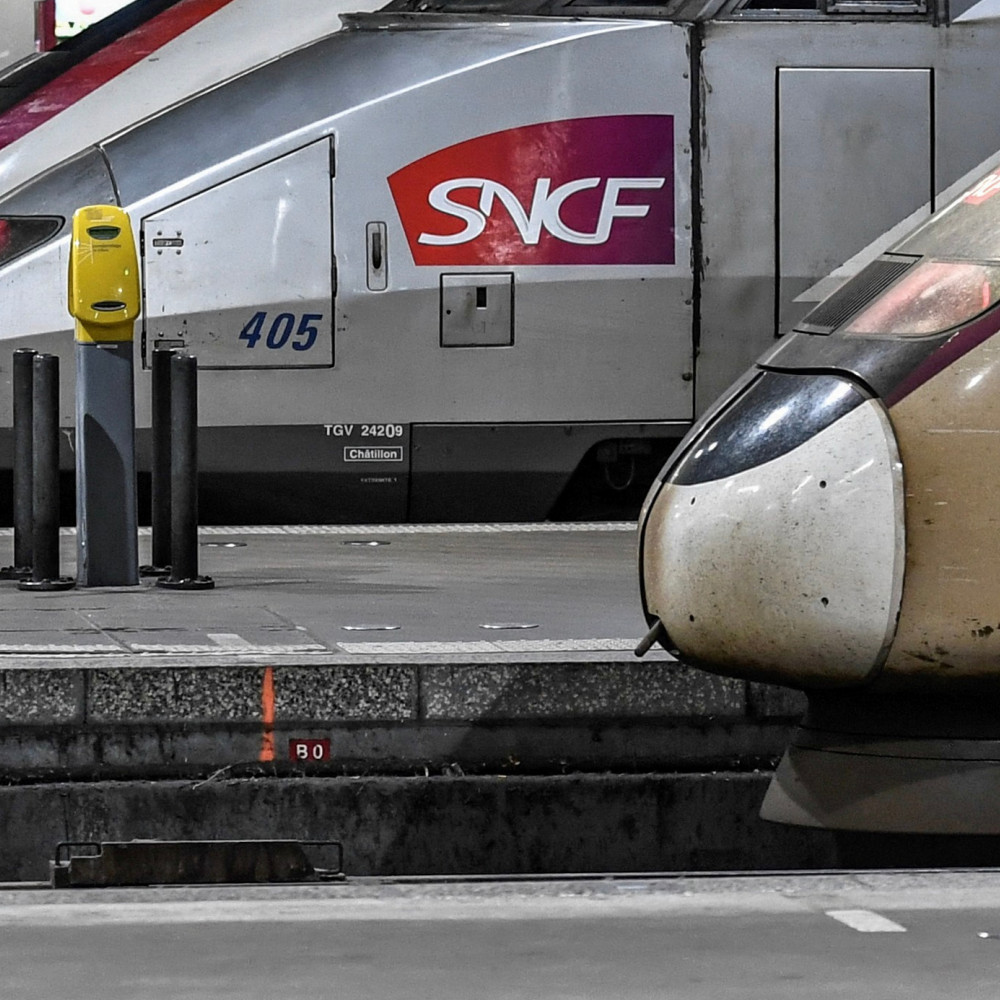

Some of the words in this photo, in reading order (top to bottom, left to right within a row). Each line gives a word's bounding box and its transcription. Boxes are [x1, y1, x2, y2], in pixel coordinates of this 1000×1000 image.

[417, 177, 666, 246] SNCF
[238, 311, 323, 351] 405
[323, 424, 354, 437] TGV
[360, 423, 404, 438] 24209
[349, 449, 398, 459] Châtillon
